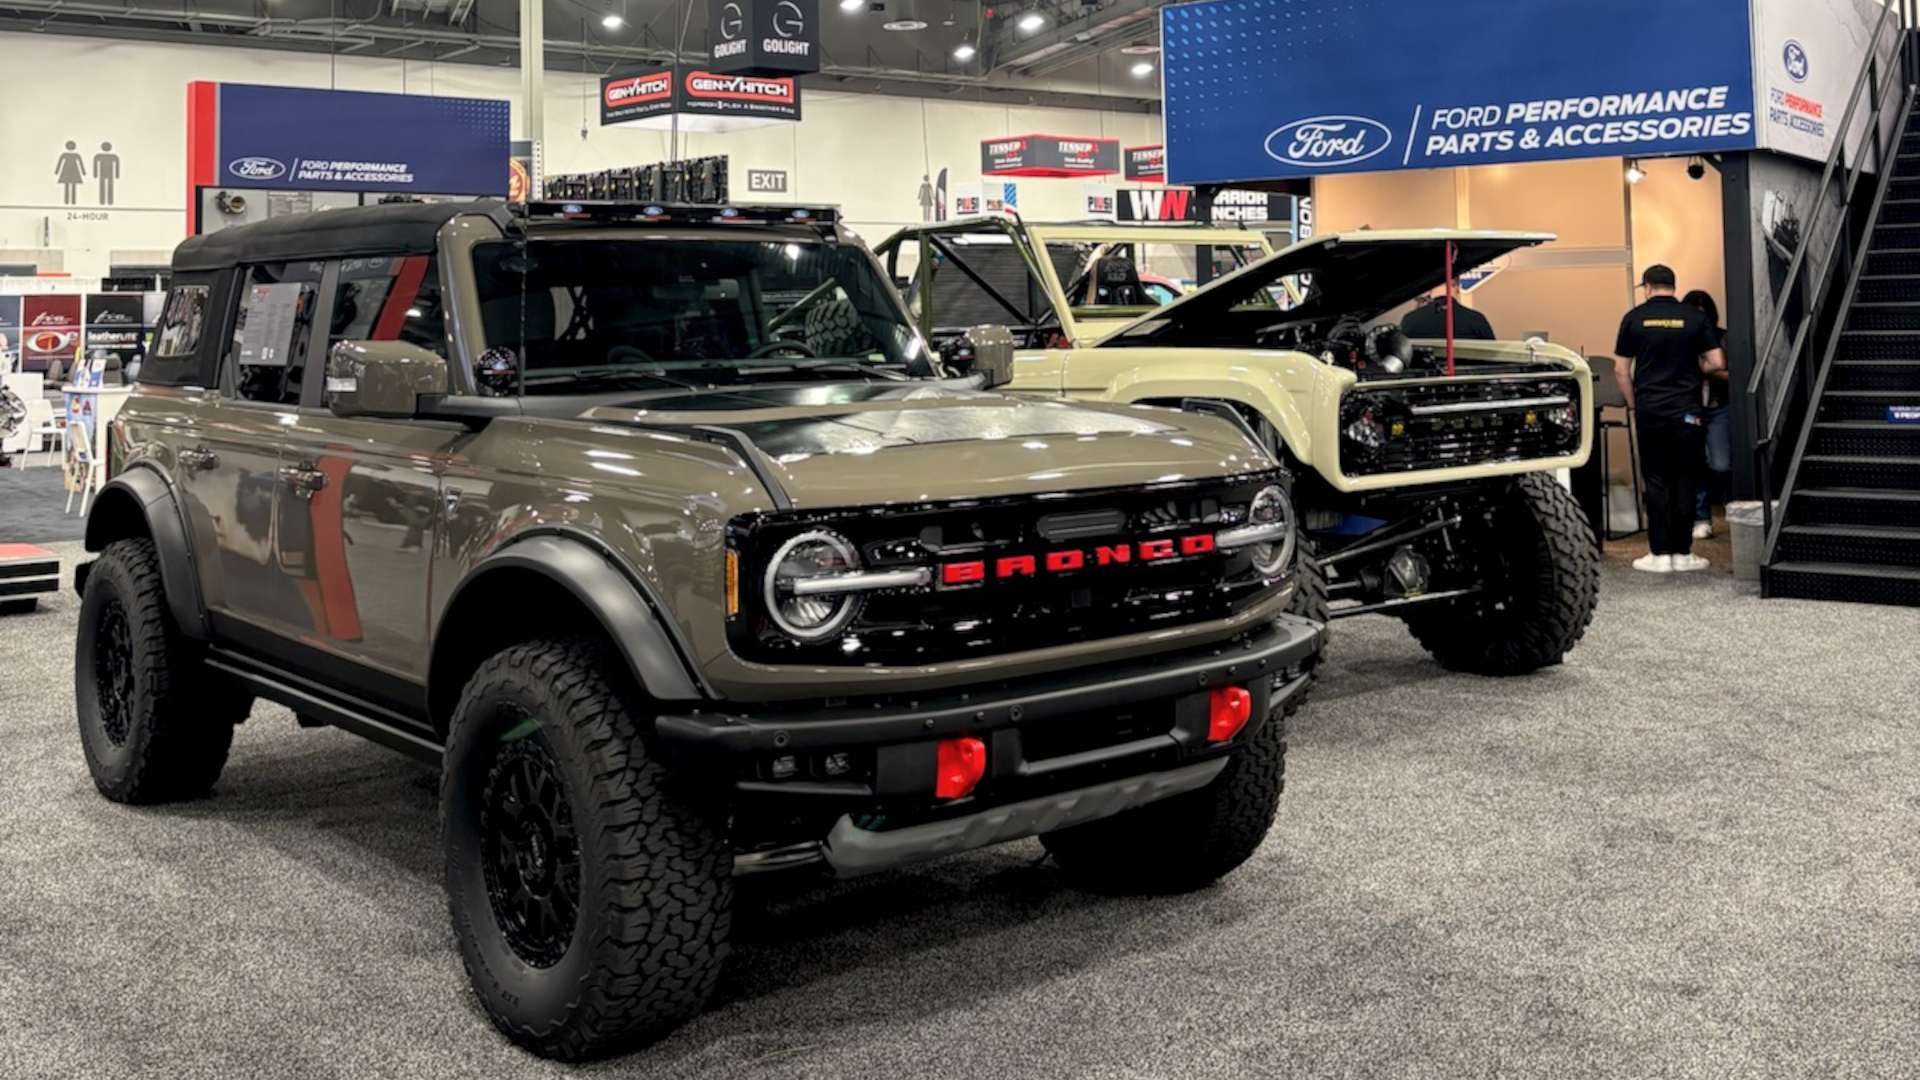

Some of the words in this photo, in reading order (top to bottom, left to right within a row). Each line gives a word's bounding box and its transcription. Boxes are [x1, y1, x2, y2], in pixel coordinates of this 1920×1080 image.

[714, 40, 747, 58] GOLIGHT
[763, 39, 810, 56] GOLIGHT
[1431, 105, 1501, 131] FORD
[1505, 86, 1729, 125] PERFORMANCE
[1288, 123, 1366, 159] Ford
[1425, 130, 1515, 156] PARTS
[1519, 127, 1541, 150] &
[1545, 112, 1752, 148] ACCESSORIES
[240, 160, 276, 175] Ford
[301, 160, 329, 170] FORD
[330, 161, 408, 173] PERFORMANCE
[298, 170, 333, 180] PARTS
[334, 171, 342, 181] &
[344, 171, 414, 183] ACCESSORIES
[751, 173, 785, 190] EXIT
[67, 211, 109, 221] 24-HOUR
[1211, 206, 1268, 220] NCHES
[943, 534, 1214, 583] BRONCO
